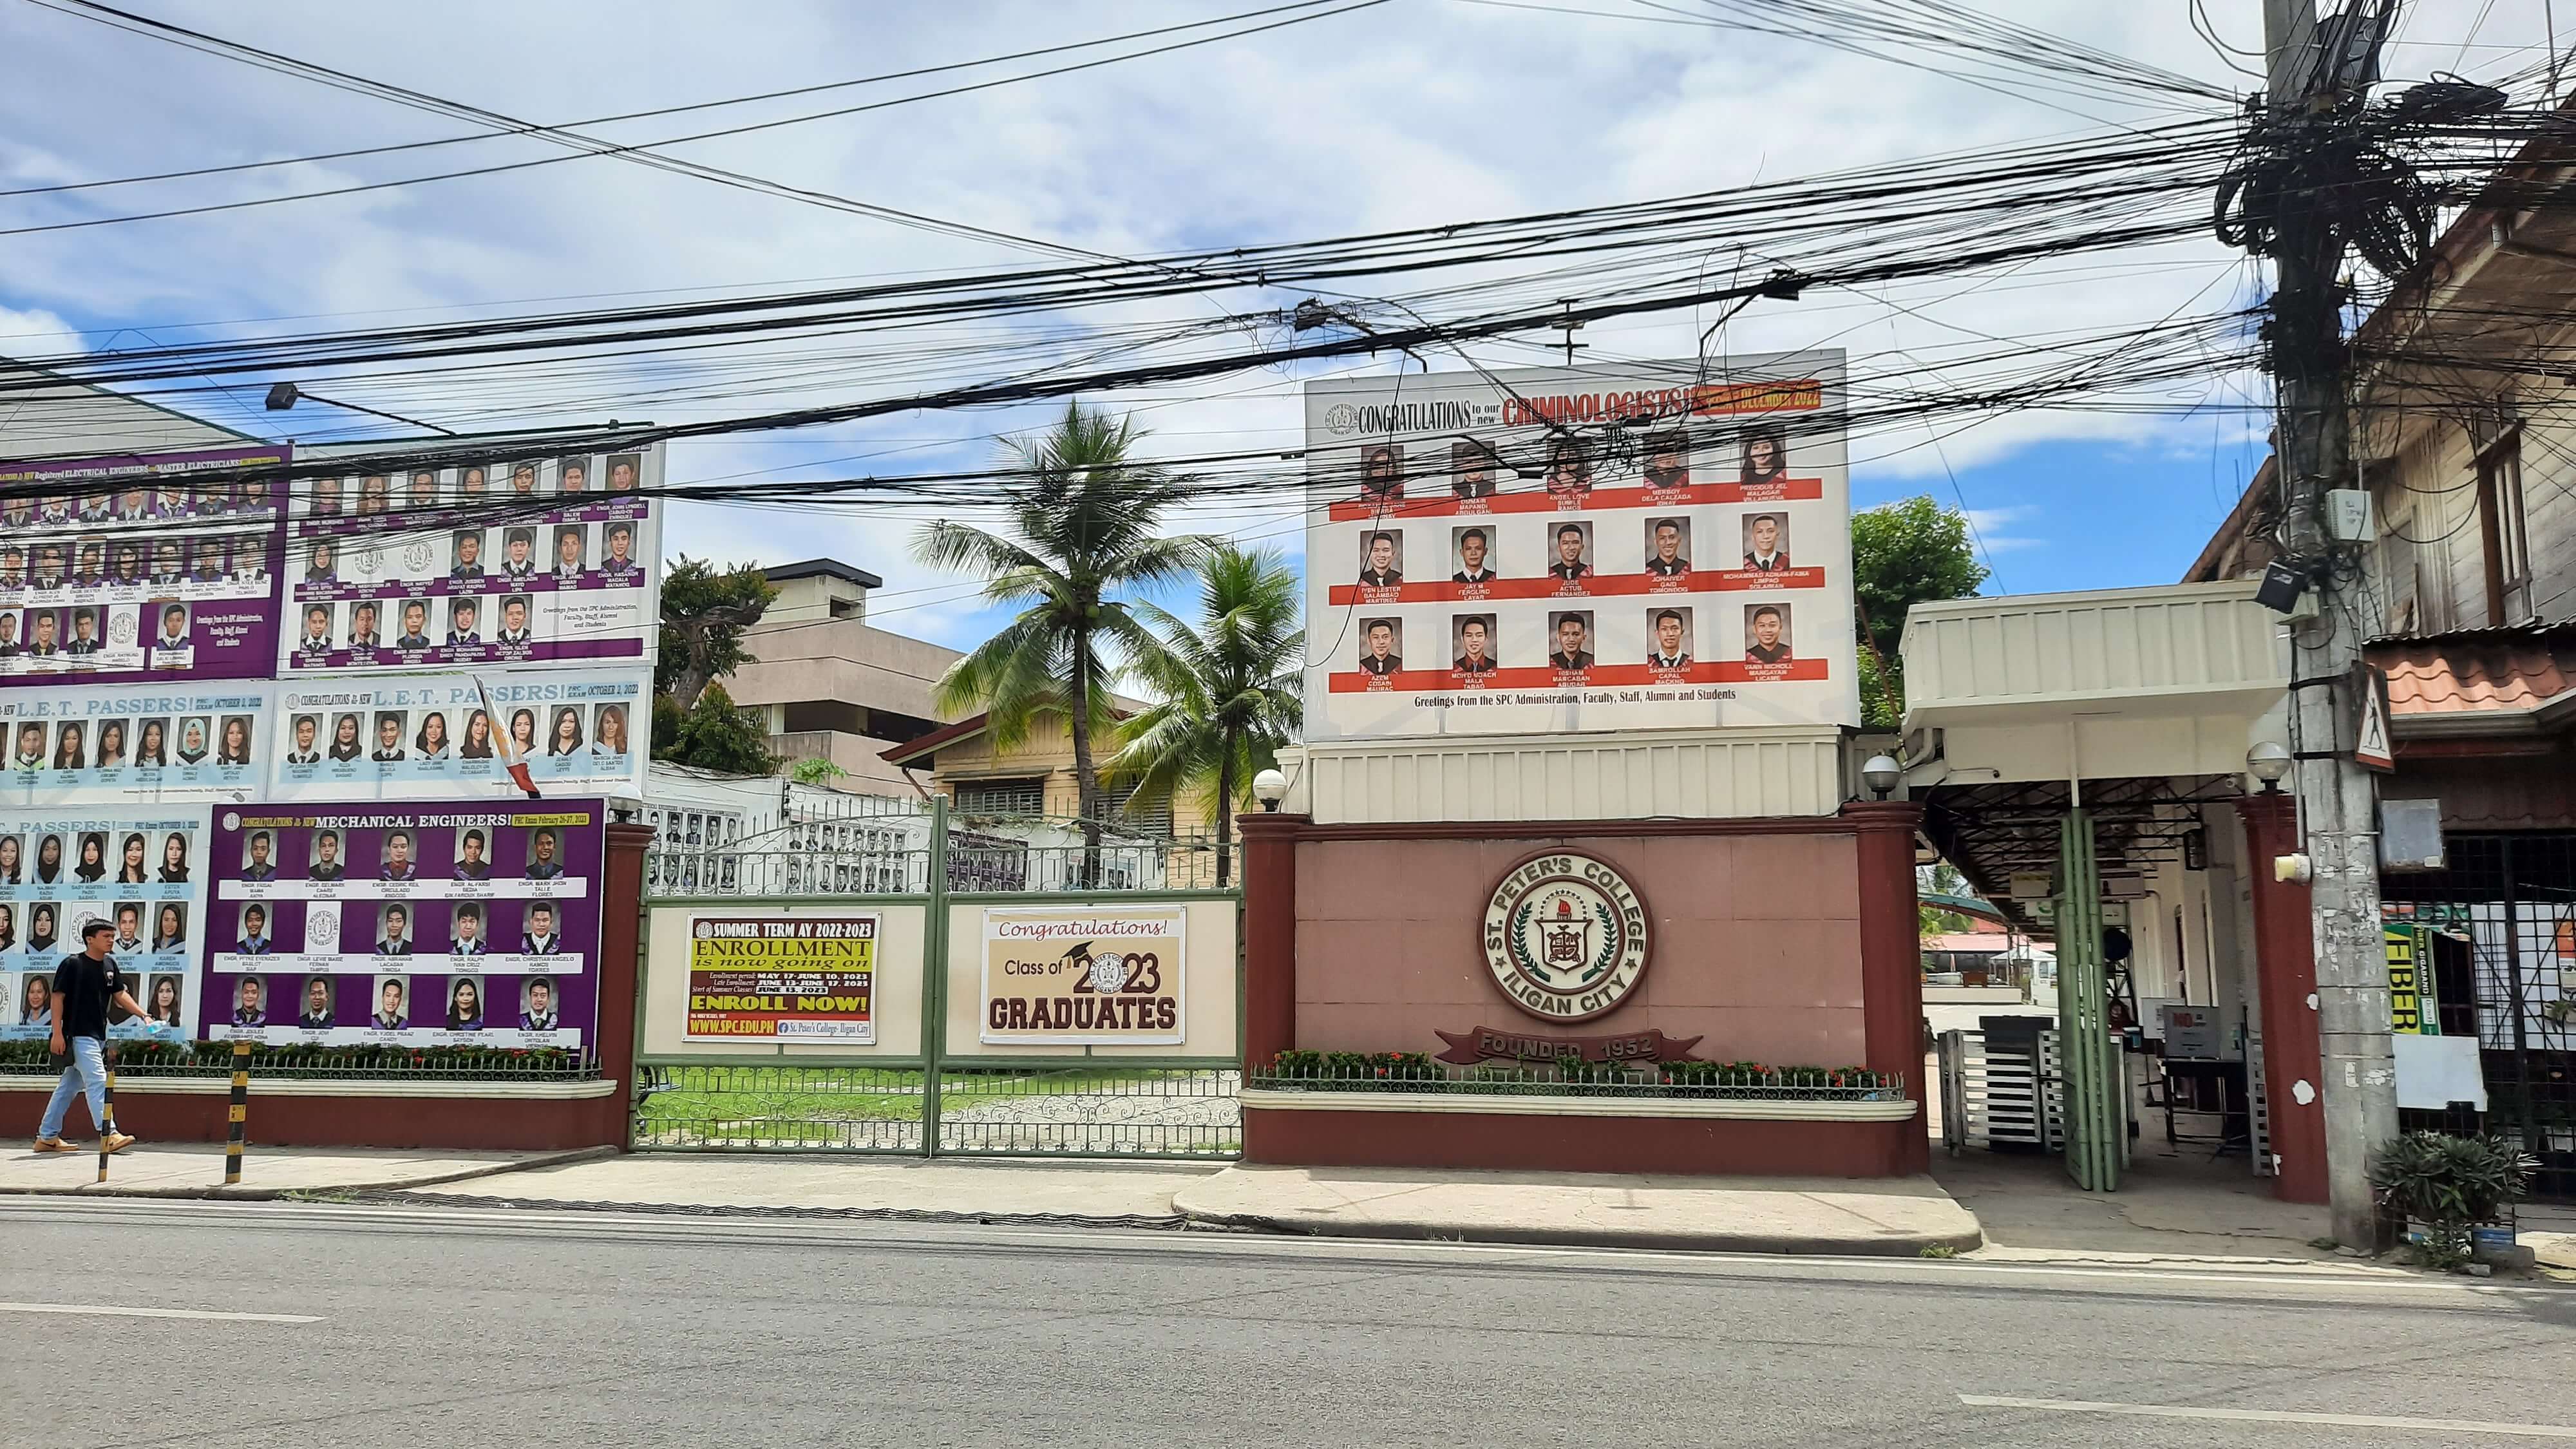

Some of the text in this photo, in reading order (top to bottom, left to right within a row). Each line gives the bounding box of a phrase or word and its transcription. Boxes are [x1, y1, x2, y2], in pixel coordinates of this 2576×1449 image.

[1358, 400, 1501, 434] CONGRATULATIONS to our
[1477, 415, 1495, 425] new
[35, 471, 64, 480] Registered
[64, 468, 107, 479] ELECTRICAL
[109, 465, 149, 476] ENGINEERS
[156, 462, 186, 473] MASTER
[374, 689, 439, 706] L.E.T.
[588, 685, 616, 696] OCTOBER
[1414, 688, 1736, 709] Greetings from the SPC Administration, Faculty, Staff, Alumni and Students
[16, 697, 193, 717] L.E.T. PASSERS!
[19, 820, 116, 833] PASSERS!
[314, 815, 414, 829] MECHANICAL
[418, 814, 511, 828] ENGINEERS!
[1487, 857, 1643, 952] ST. PETER'S COLLEGE
[713, 922, 871, 938] SUMMER TERM AY 2022-2023
[999, 919, 1168, 941] Congratulations!
[696, 940, 871, 956] ENROLLMENT
[696, 956, 712, 967] is
[773, 957, 835, 970] going
[1005, 960, 1044, 975] Class
[1048, 959, 1063, 975] of
[2418, 950, 2429, 994] GIGABAND
[1502, 971, 1625, 1014] ILIGAN CITY
[2386, 940, 2418, 1030] FIBER
[691, 996, 867, 1011] ENROLL NOW!
[989, 997, 1176, 1029] GRADUATES
[690, 1019, 775, 1034] WWW.SPC.EDU.PH
[798, 1022, 815, 1032] Peter's
[840, 1022, 856, 1036] Iligan
[857, 1022, 869, 1036] City
[1480, 1033, 1653, 1058] FOUNDED 1952
